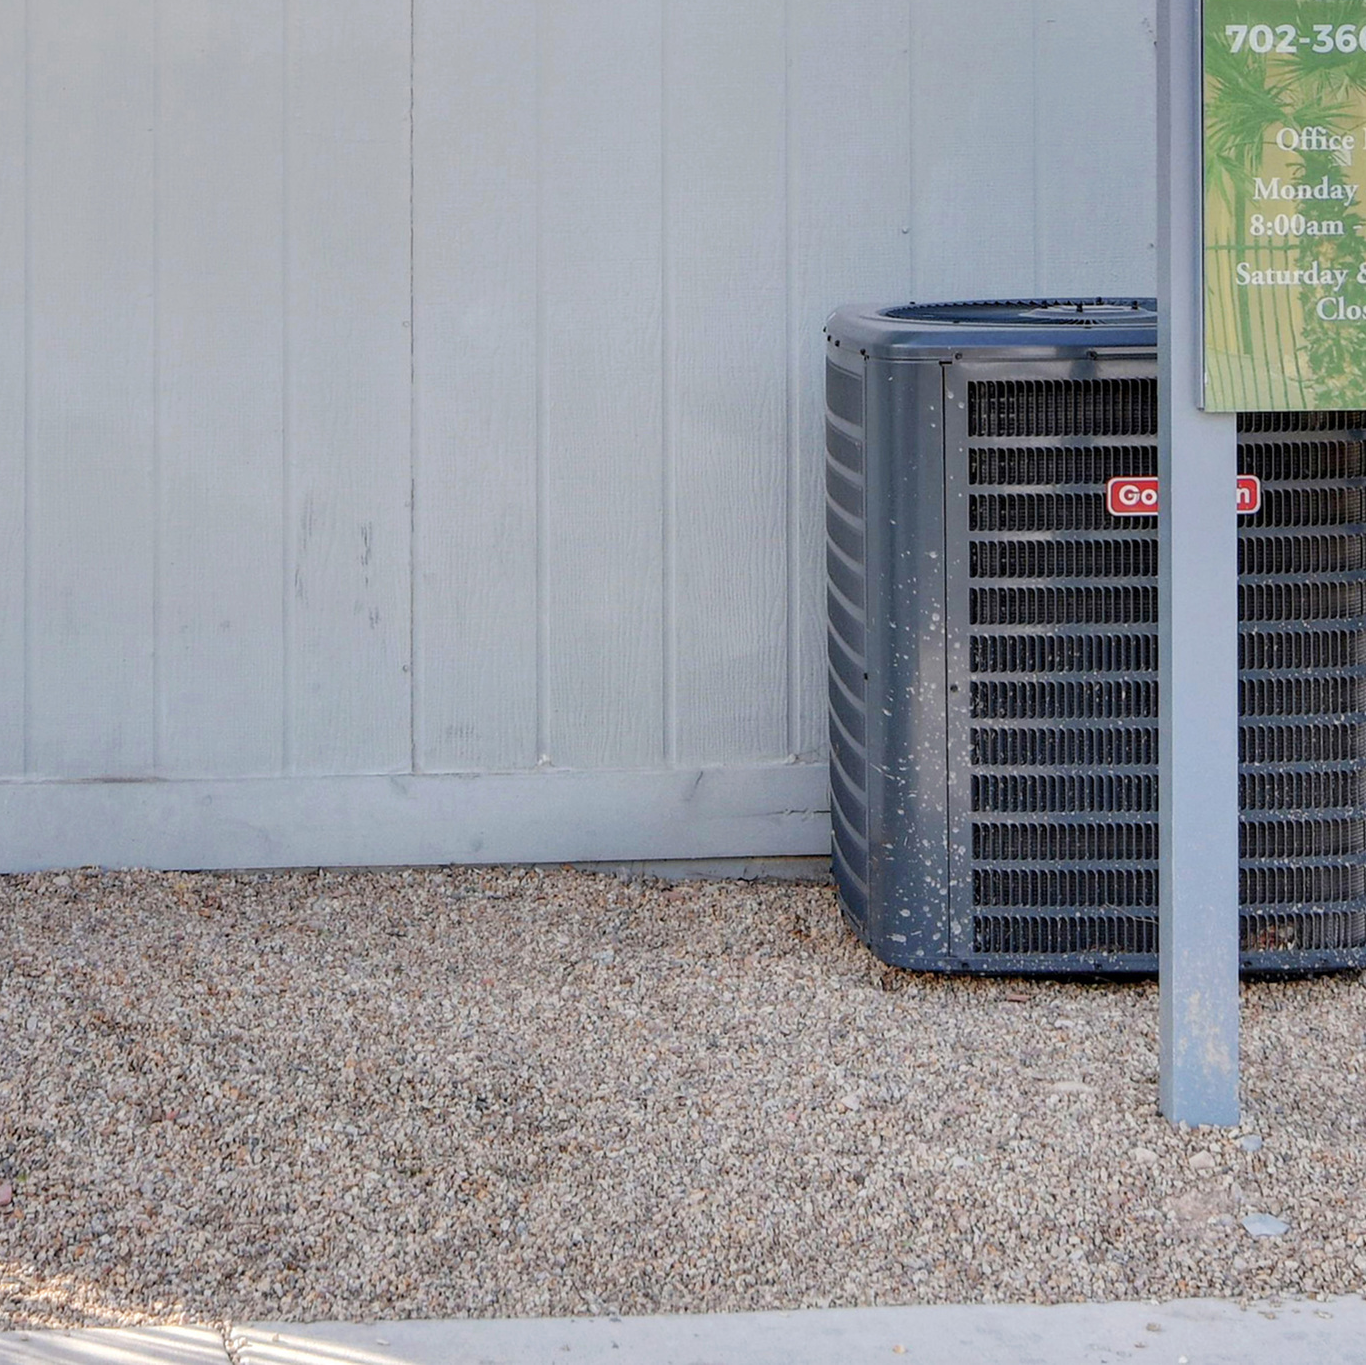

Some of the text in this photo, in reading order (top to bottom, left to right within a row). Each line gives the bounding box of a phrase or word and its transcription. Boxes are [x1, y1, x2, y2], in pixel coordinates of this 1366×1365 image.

[1275, 126, 1354, 152] Office
[1252, 177, 1358, 206] Monday
[1249, 214, 1344, 237] 8:00am
[1236, 262, 1348, 291] Saturday
